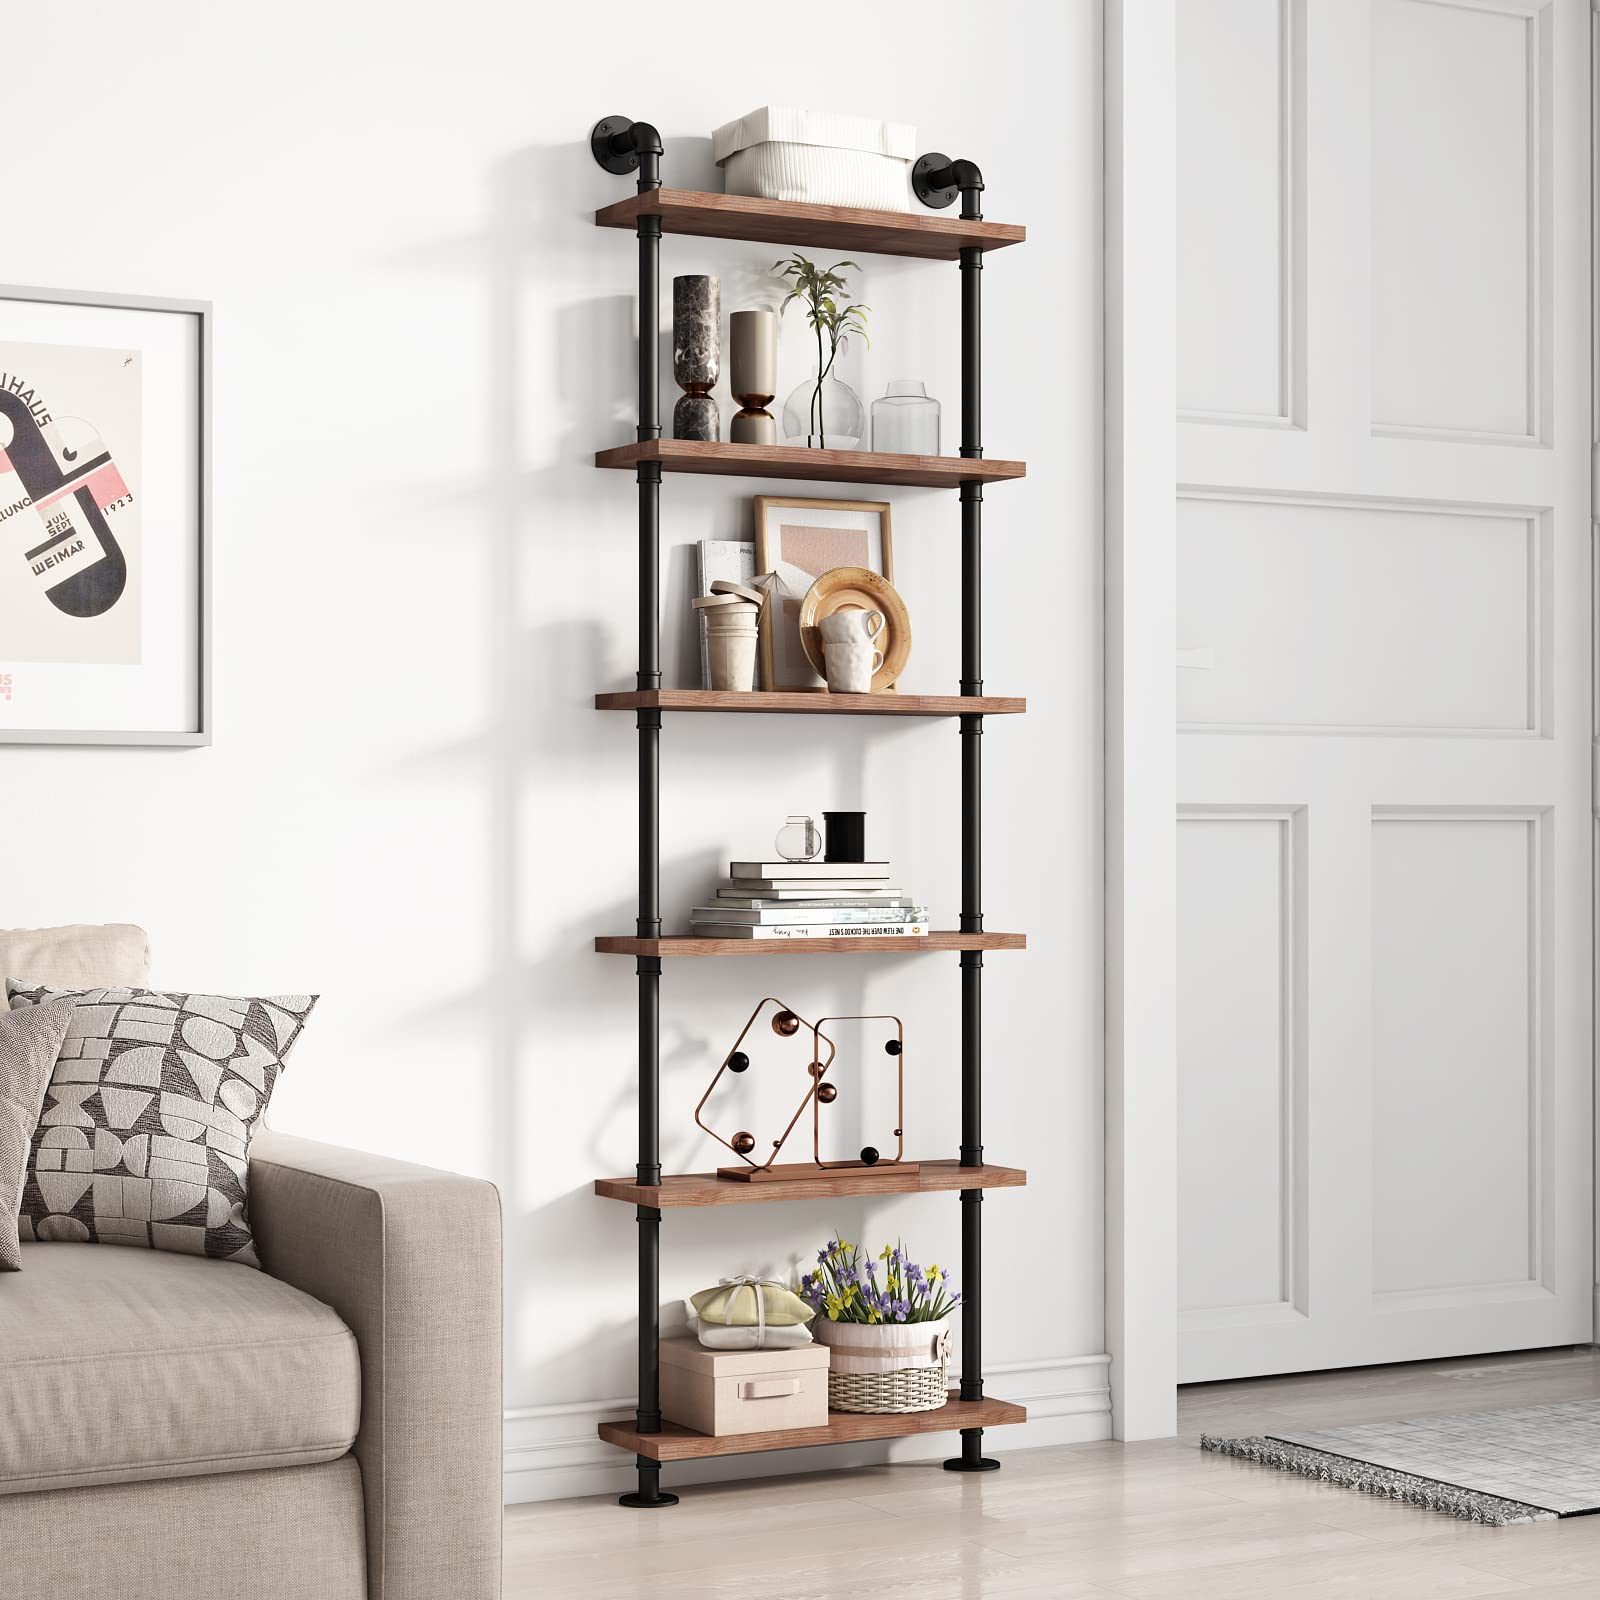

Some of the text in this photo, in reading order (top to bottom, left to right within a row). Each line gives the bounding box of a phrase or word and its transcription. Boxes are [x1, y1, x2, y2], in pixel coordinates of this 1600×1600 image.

[0, 497, 32, 522] LUNG
[104, 493, 133, 515] 1923
[45, 512, 67, 529] JULI
[48, 518, 72, 537] SEPT
[32, 540, 85, 576] WEIMAR
[862, 928, 871, 936] THE
[883, 927, 895, 935] FLEW
[895, 927, 904, 935] ONE
